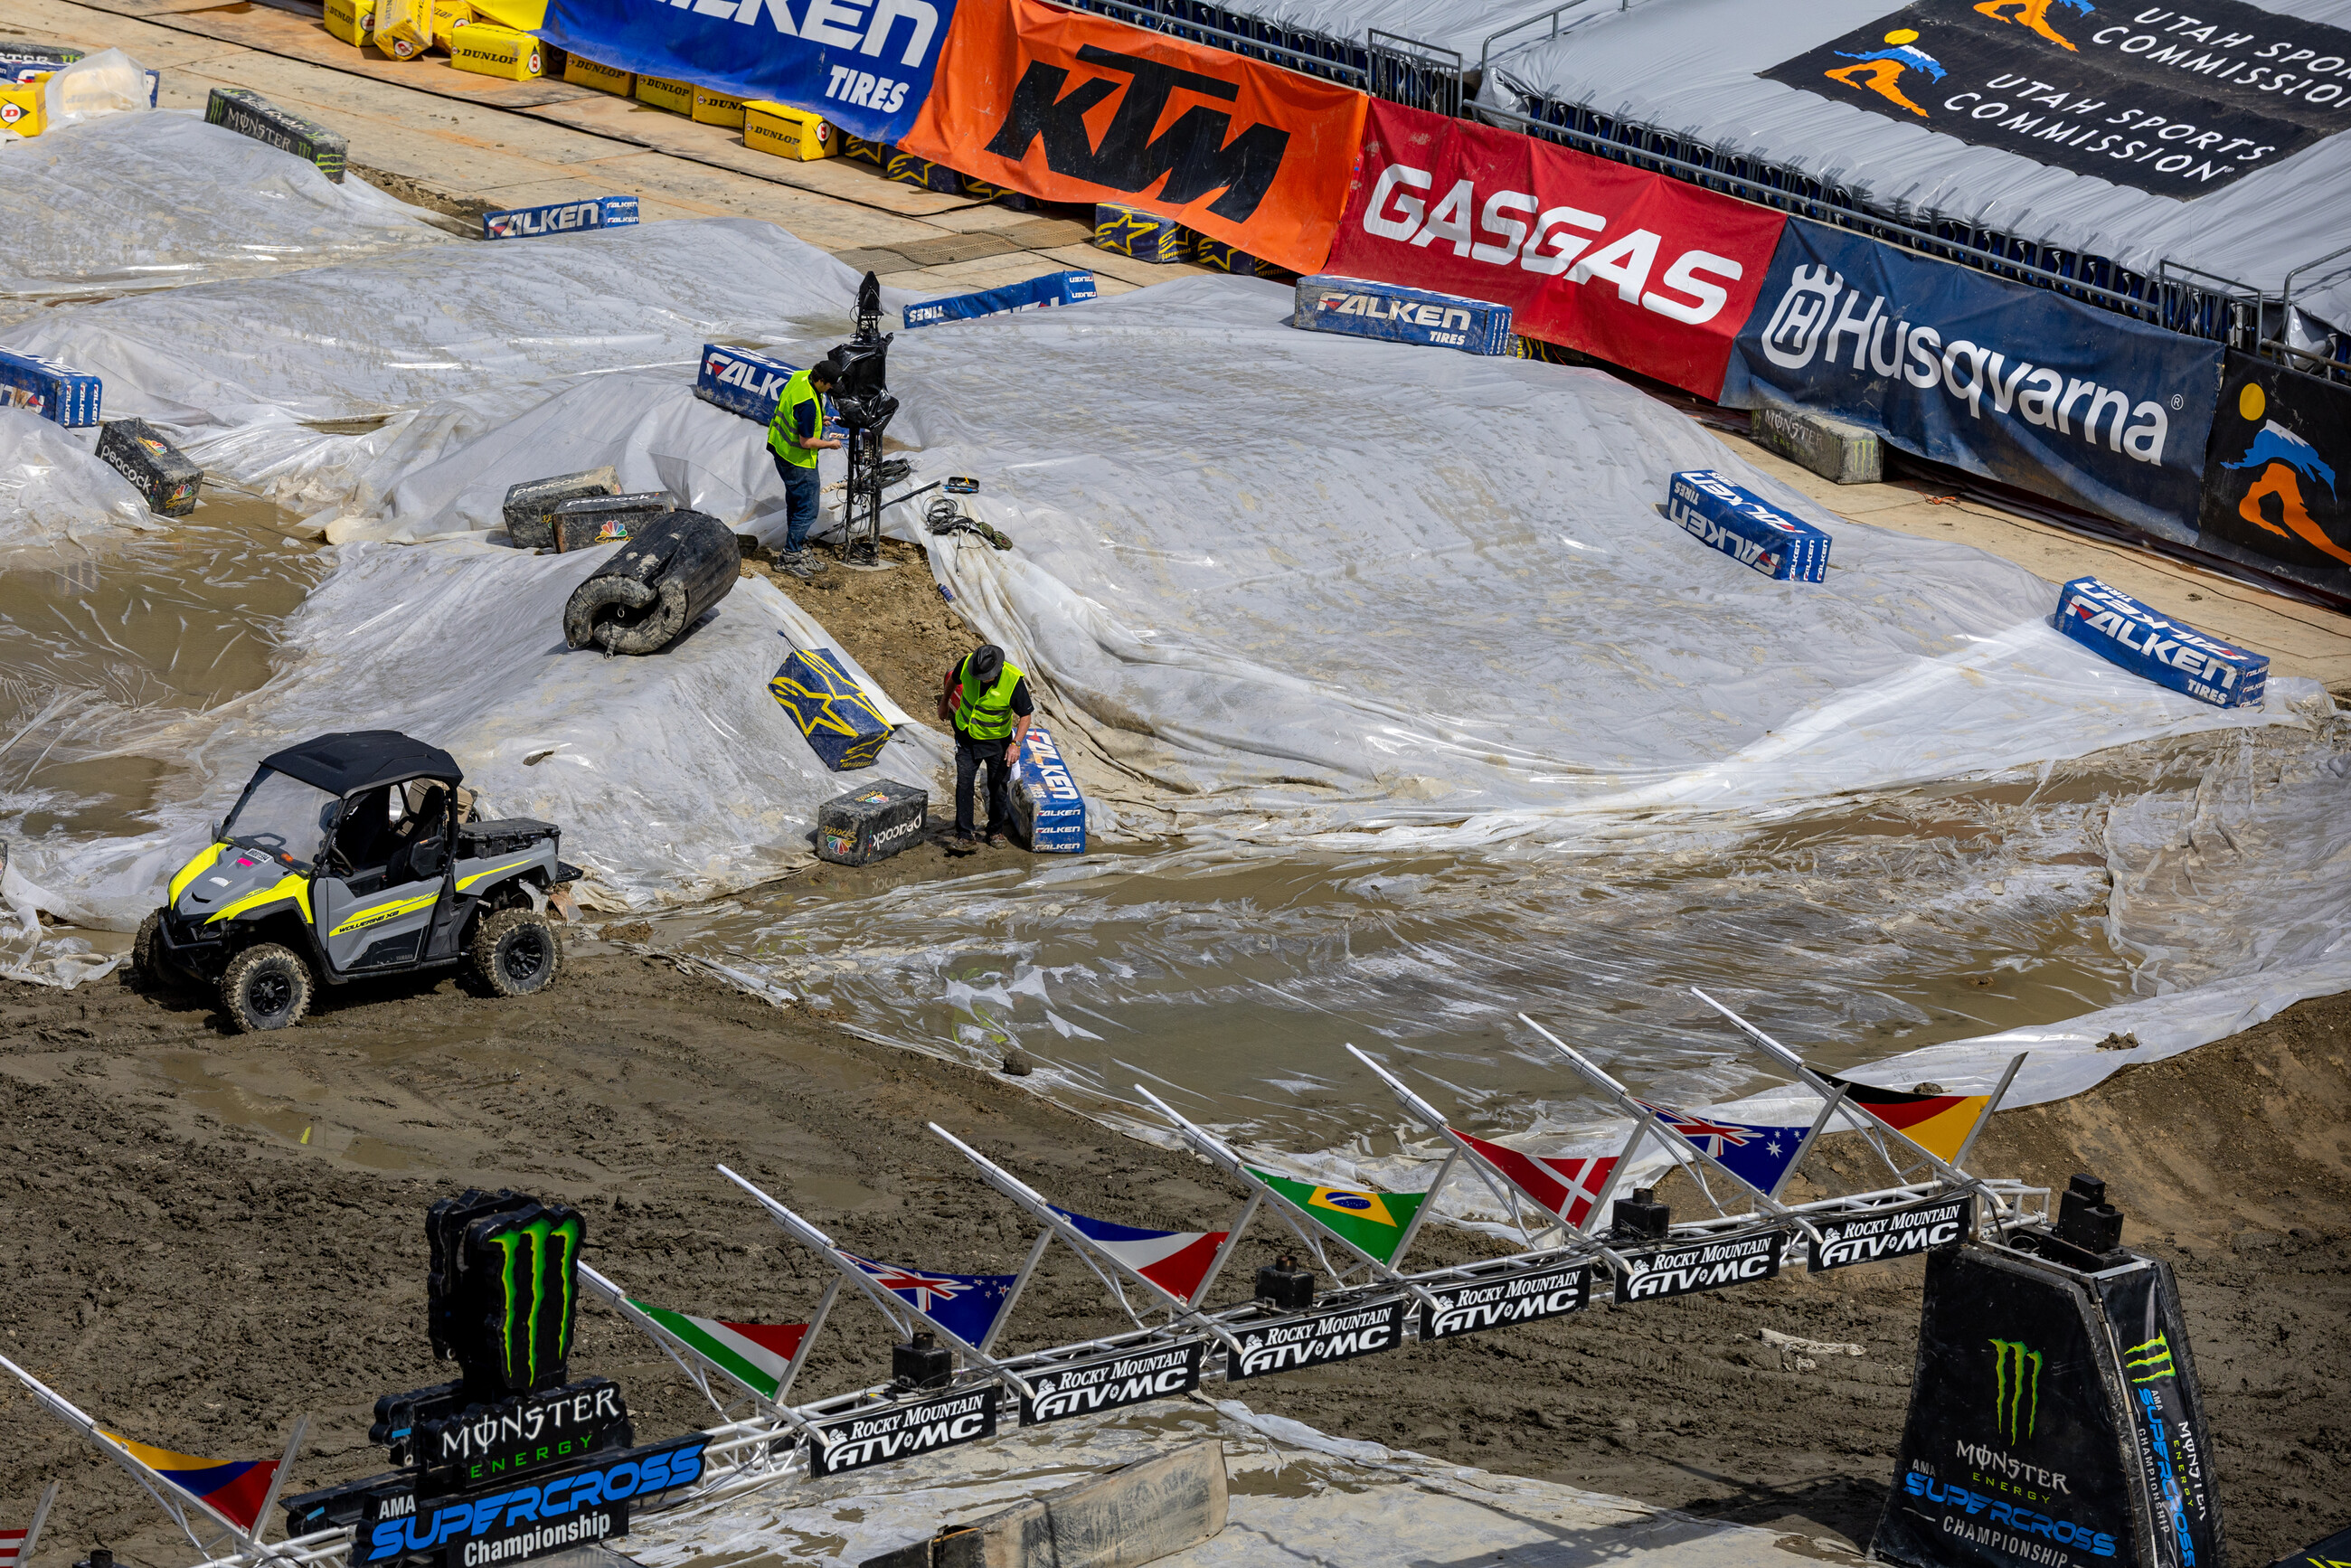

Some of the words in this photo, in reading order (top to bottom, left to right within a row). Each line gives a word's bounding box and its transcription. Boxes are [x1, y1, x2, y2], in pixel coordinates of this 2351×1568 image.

[329, 6, 354, 25] DUNLOP
[2134, 7, 2254, 48] UTAH
[462, 48, 518, 65] DUNLOP
[575, 60, 626, 80] DUNLOP
[2092, 26, 2351, 109] COMMISSIO
[647, 78, 690, 98] DUNLOP
[825, 64, 910, 114] TIRES
[753, 126, 801, 145] DUNLOP
[983, 43, 1290, 224] KTM
[1944, 92, 2229, 182] COMMISSION
[1987, 73, 2107, 114] UTAH
[2106, 109, 2275, 161] SPORTS
[488, 203, 599, 239] FALKEN
[1363, 163, 1742, 325] GASGAS
[909, 305, 945, 323] TIRES
[1317, 291, 1472, 331] FALKEN
[1430, 331, 1466, 345] TIRES
[704, 353, 788, 401] FALK
[1825, 289, 2170, 467] Husqvarna
[63, 385, 72, 426] FALKEN
[78, 383, 86, 426] FALKEN
[91, 383, 99, 425] FALKEN
[100, 445, 152, 493] peacock
[513, 474, 591, 498] peacock
[566, 494, 651, 507] peacock
[1675, 482, 1700, 505] TIRES
[1681, 471, 1808, 535] FALKEN
[1669, 497, 1781, 577] FALKEN
[1789, 539, 1801, 581] FALKEN
[1803, 539, 1815, 581] FALKEN
[1817, 539, 1828, 581] FALKEN
[2092, 580, 2135, 602] TIRES
[2074, 582, 2250, 661] FALKEN
[2064, 595, 2239, 691] FALKEN
[2188, 679, 2228, 705] TIRES
[1026, 729, 1079, 799] FALKEN
[1035, 826, 1081, 834] FALKEN
[1035, 843, 1081, 851] FALKEN
[339, 914, 385, 932] WOLVERINE
[1843, 1219, 1889, 1239] ROCKY
[1890, 1204, 1960, 1232] MOUNTAIN
[1651, 1251, 1700, 1271] ROCKY
[1700, 1237, 1771, 1264] MOUNTAIN
[1456, 1286, 1505, 1308] ROCKY
[1506, 1270, 1581, 1299] MOUNTAIN
[1265, 1324, 1315, 1346] ROCKY
[1316, 1308, 1392, 1337] MOUNTAIN
[1058, 1367, 1109, 1391] ROCKY
[1110, 1349, 1190, 1379] MOUNTAIN
[850, 1414, 902, 1440] ROCKY
[902, 1393, 985, 1428] MOUNTAIN
[2151, 1390, 2163, 1411] AMA
[442, 1386, 620, 1459] MONSTER
[470, 1434, 593, 1478] ENERGY
[1912, 1459, 1936, 1478] AMA
[1956, 1439, 2072, 1495] MONSTER
[2173, 1440, 2194, 1507] ENERGY
[1972, 1472, 2051, 1504] ENERGY
[2138, 1388, 2195, 1568] SUPERCROSS
[2139, 1428, 2170, 1533] CHAMPIONSHIP
[367, 1443, 705, 1561] SUPERCROSS
[379, 1493, 417, 1520] AMA
[1903, 1472, 2118, 1557] SUPERCROSS
[464, 1510, 610, 1567] Championship
[1943, 1516, 2069, 1568] CHAMPIONSHIP
